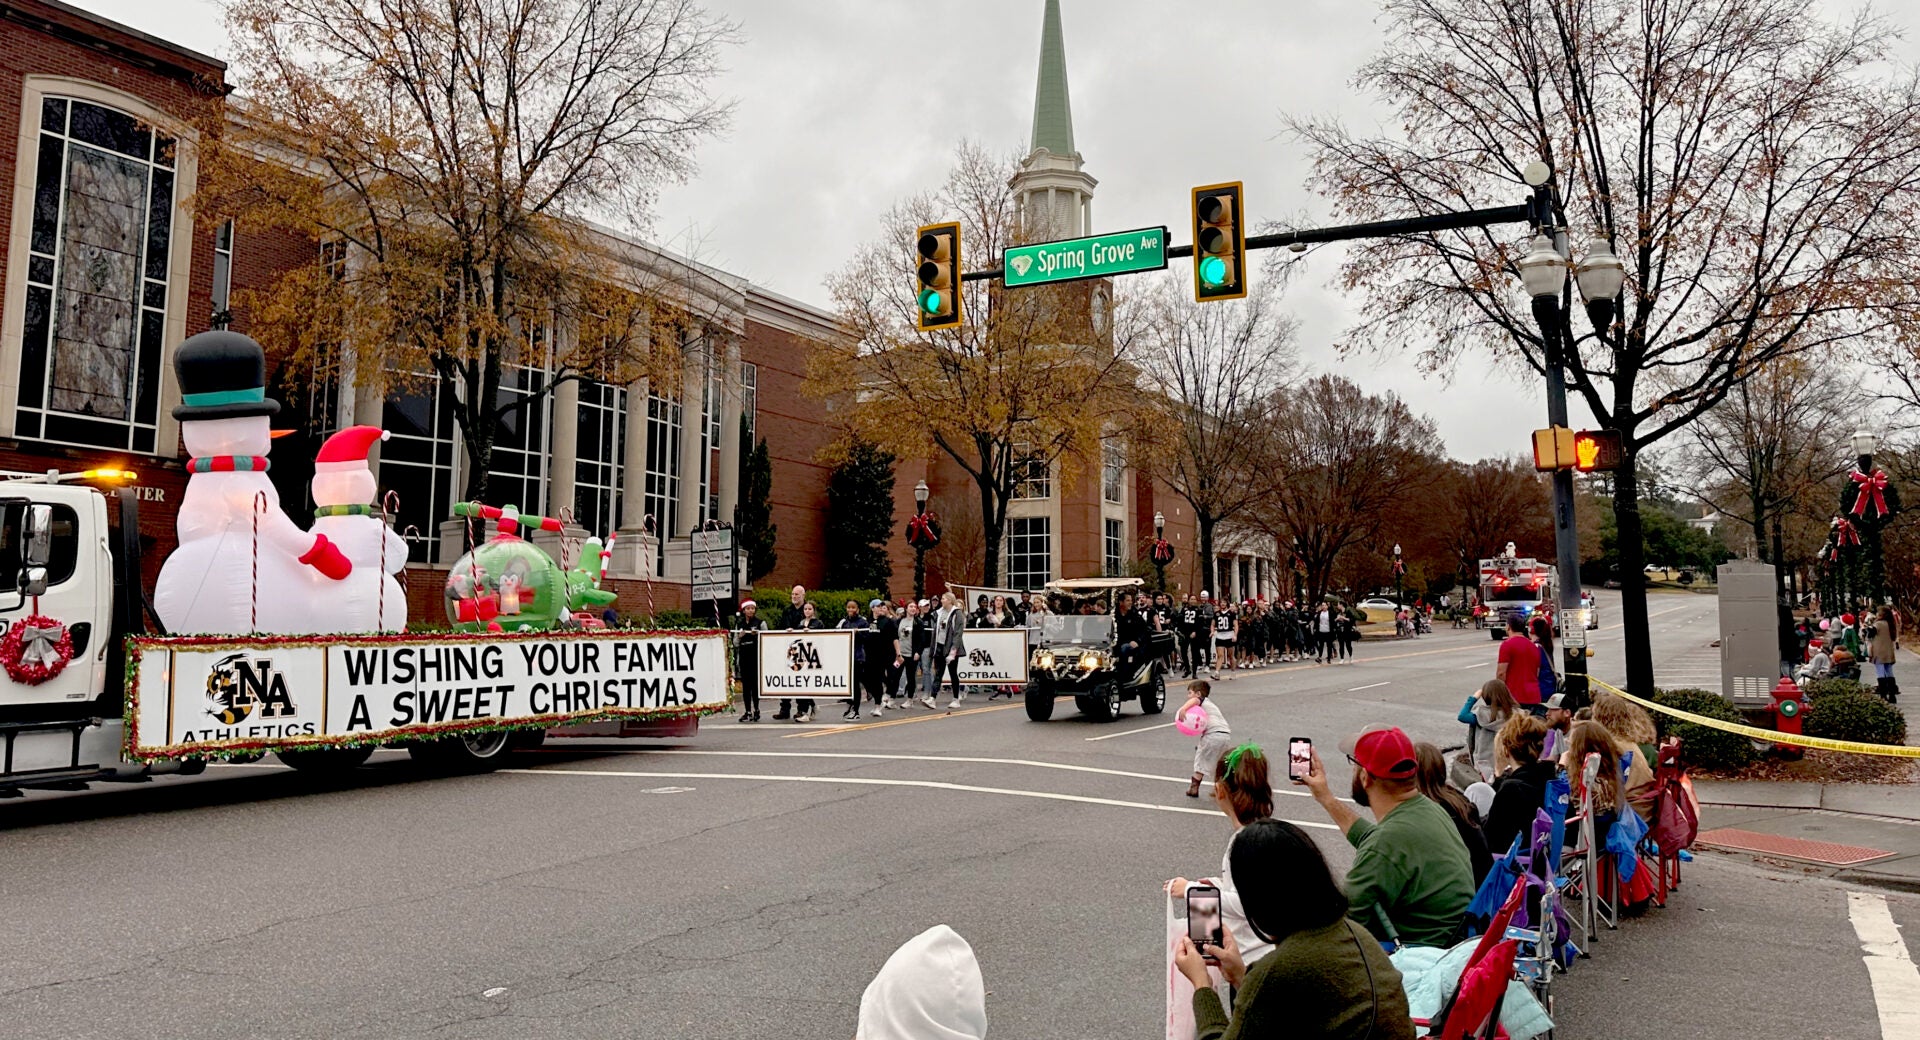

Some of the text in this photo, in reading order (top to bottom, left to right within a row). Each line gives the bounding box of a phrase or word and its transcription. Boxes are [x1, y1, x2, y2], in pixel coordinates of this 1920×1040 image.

[1037, 235, 1158, 277] Spring Grove Ave
[1184, 610, 1196, 624] 22
[1217, 616, 1229, 630] 20
[344, 642, 697, 686] WISHING YOUR FAMILY
[797, 642, 822, 669] NA
[977, 649, 994, 666] NA
[765, 675, 847, 687] VOLLEY BALL
[958, 671, 1012, 679] OFTBALL
[232, 658, 297, 719] NA
[347, 676, 697, 731] A SWEET CHRISTMAS
[183, 722, 315, 743] ATHLETICS
